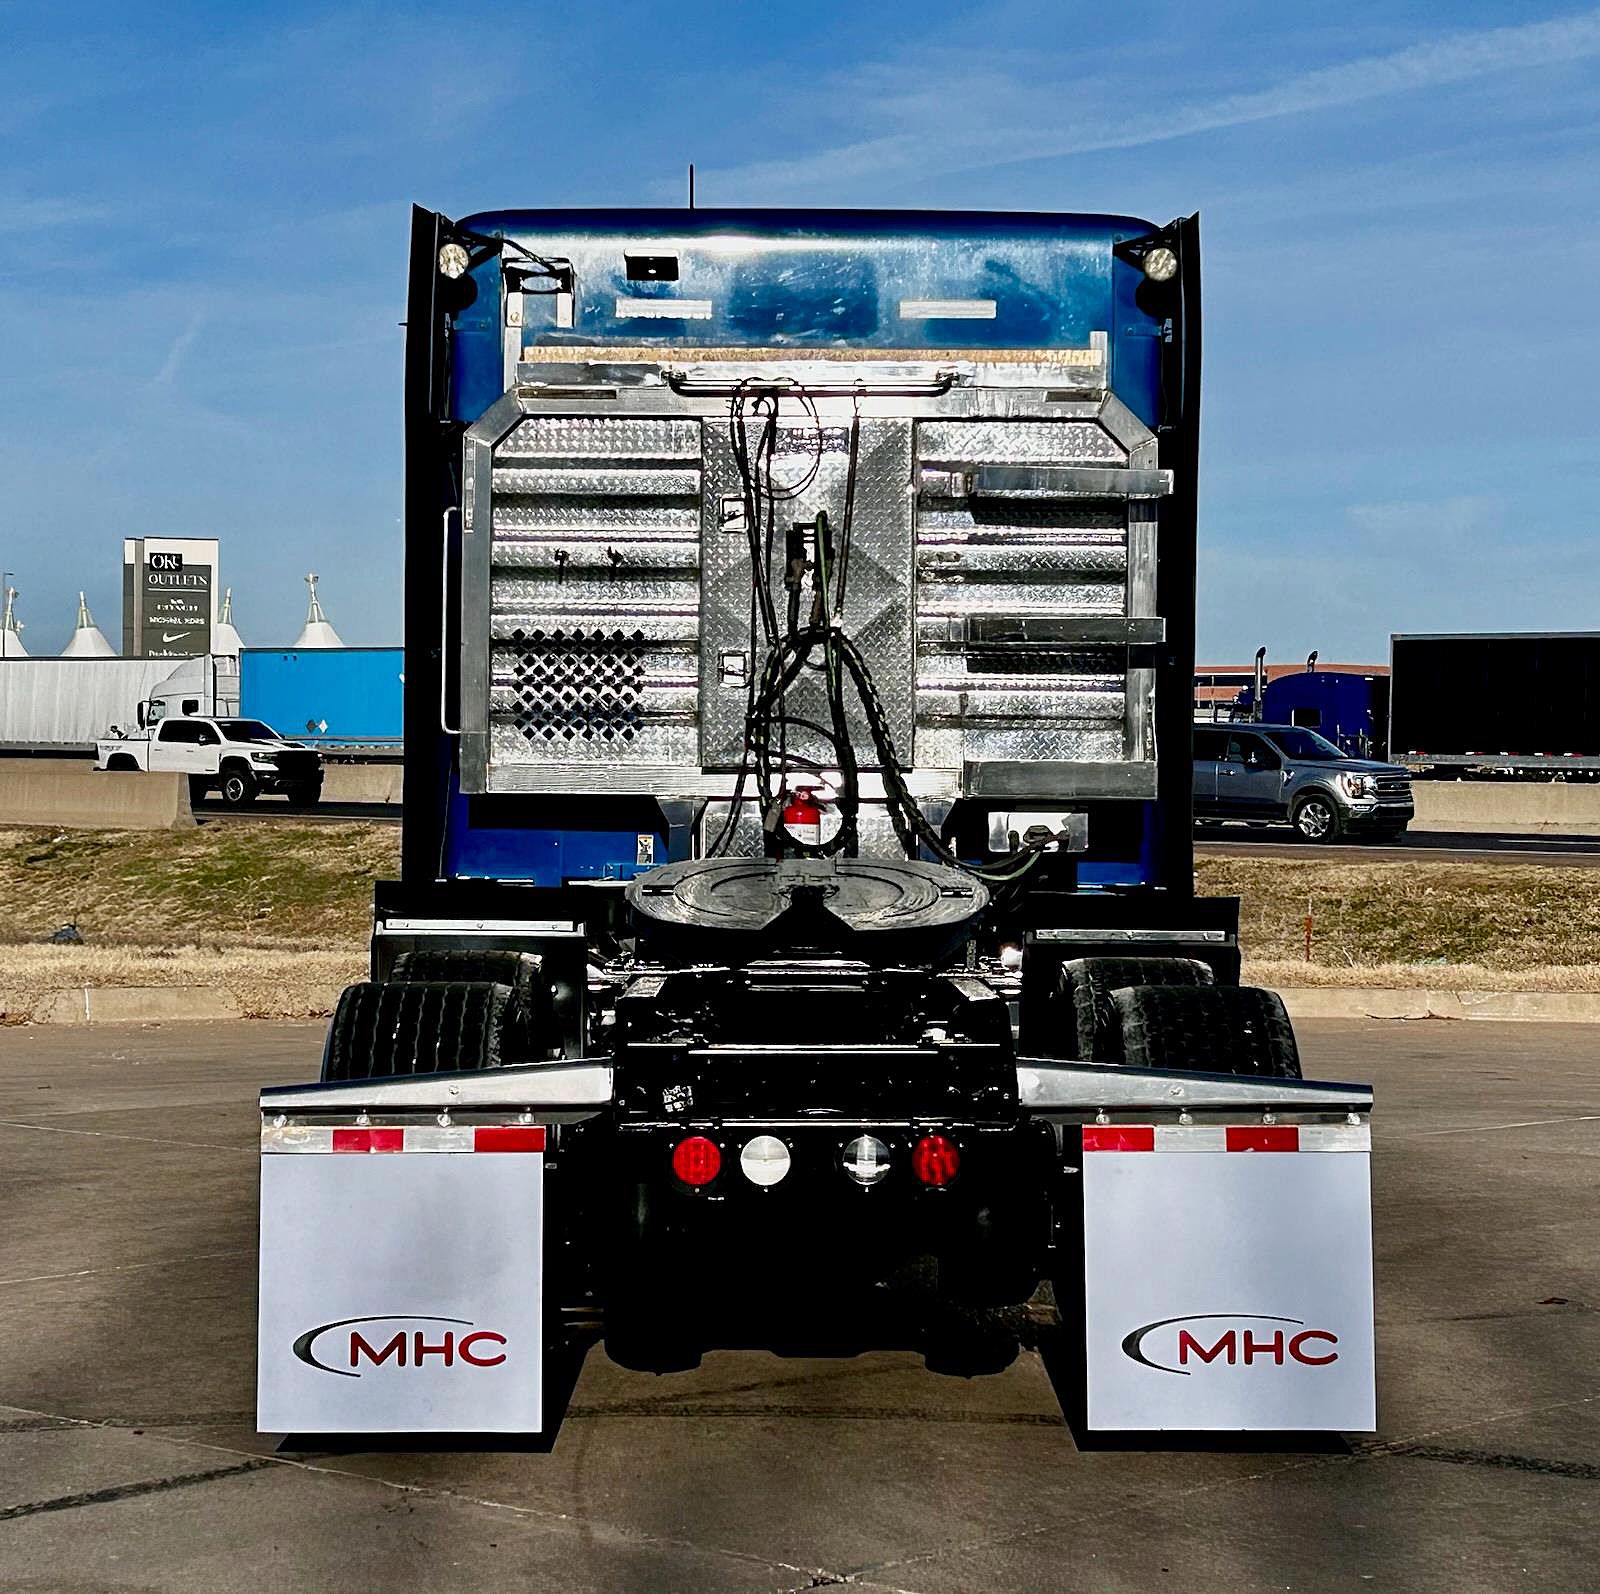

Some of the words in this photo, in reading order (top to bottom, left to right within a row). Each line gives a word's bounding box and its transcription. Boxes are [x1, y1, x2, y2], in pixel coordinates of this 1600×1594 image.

[148, 573, 208, 586] OUTLETS
[349, 1330, 507, 1368] MHC
[1179, 1329, 1339, 1366] MHC
